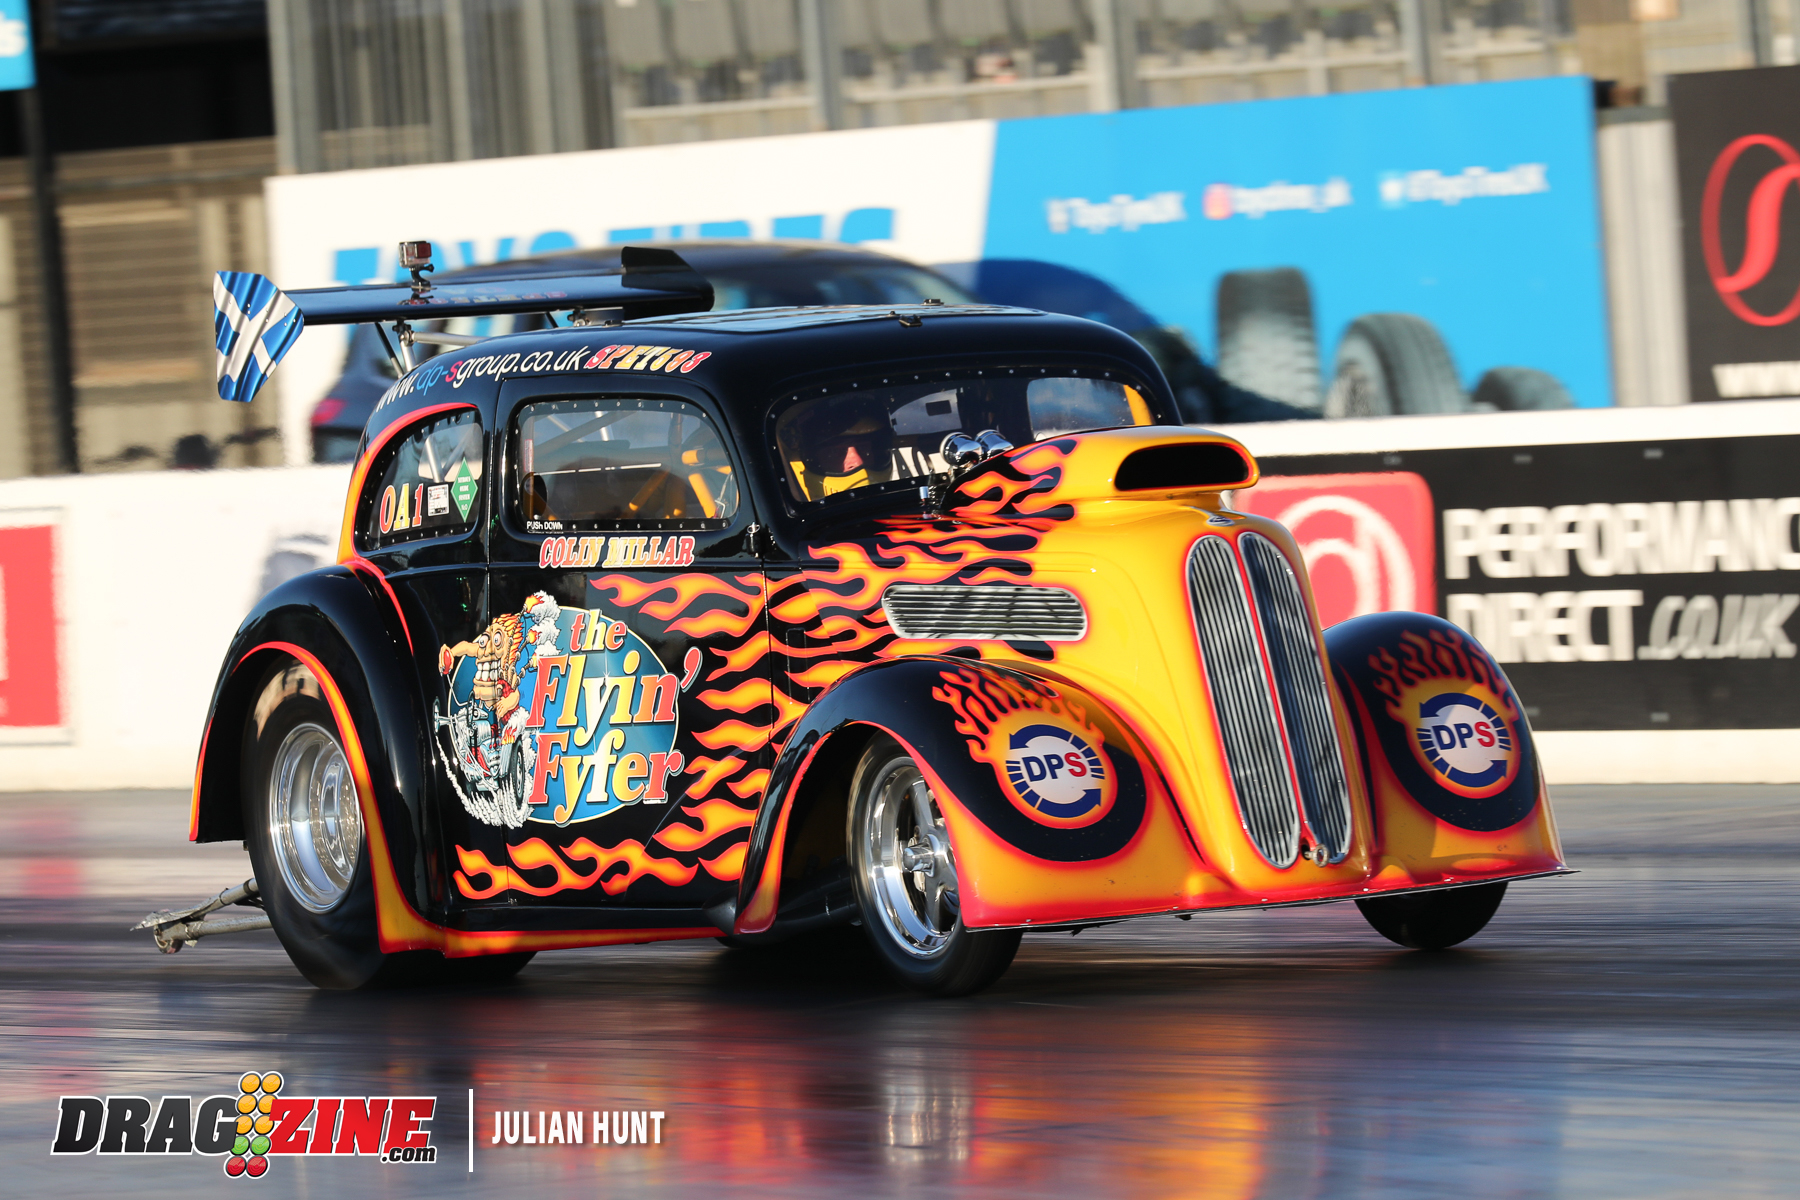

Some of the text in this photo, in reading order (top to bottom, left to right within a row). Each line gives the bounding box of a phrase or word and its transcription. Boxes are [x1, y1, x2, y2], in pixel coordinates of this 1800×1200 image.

[539, 536, 695, 569] COLIN MILLAR
[570, 608, 627, 653] the
[1432, 722, 1495, 750] DPS
[528, 729, 685, 828] Fyfer
[1021, 752, 1087, 782] DPS
